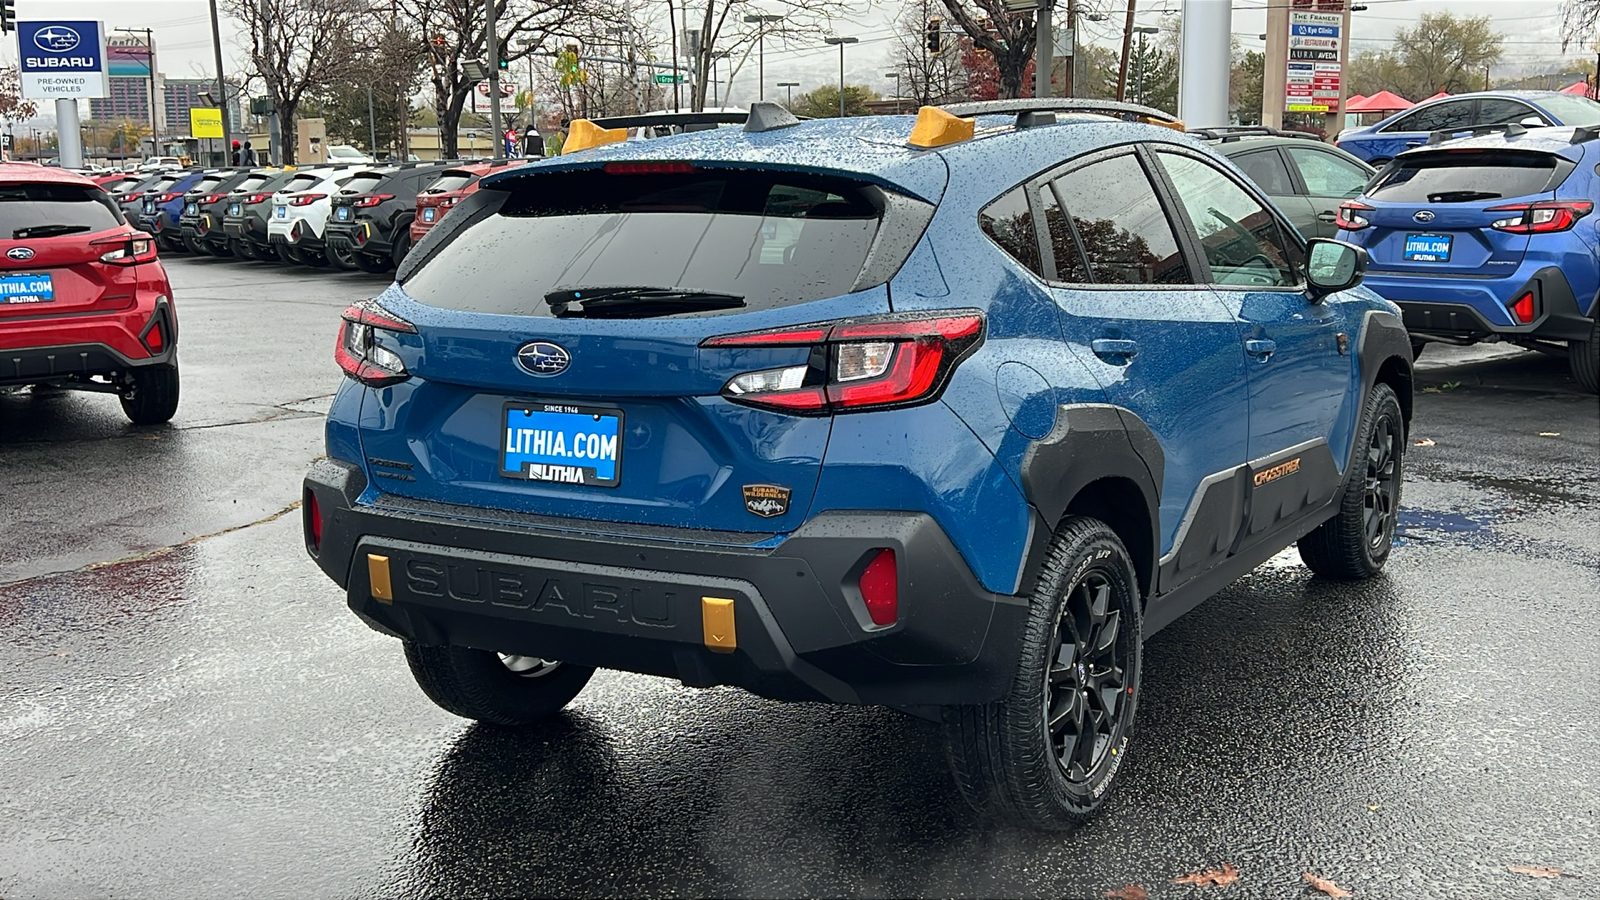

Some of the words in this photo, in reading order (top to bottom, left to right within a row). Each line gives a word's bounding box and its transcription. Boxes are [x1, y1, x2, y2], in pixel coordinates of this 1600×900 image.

[1308, 27, 1317, 35] Eye
[1318, 27, 1333, 35] Clinic
[1304, 38, 1331, 47] RESTAURANT
[26, 57, 94, 68] SUBARU
[42, 85, 81, 93] VEHICLES
[1406, 241, 1449, 253] LITHIA.COM
[0, 280, 53, 295] ITHIA.COM
[544, 405, 563, 413] SINCE
[564, 406, 579, 414] 1946
[506, 427, 617, 461] LITHIA.COM
[541, 464, 585, 484] LITHIA
[1254, 457, 1301, 487] CROSSTREK
[744, 490, 787, 499] WILDERNESS
[752, 486, 780, 494] SUBARU
[406, 559, 678, 628] SUBARU
